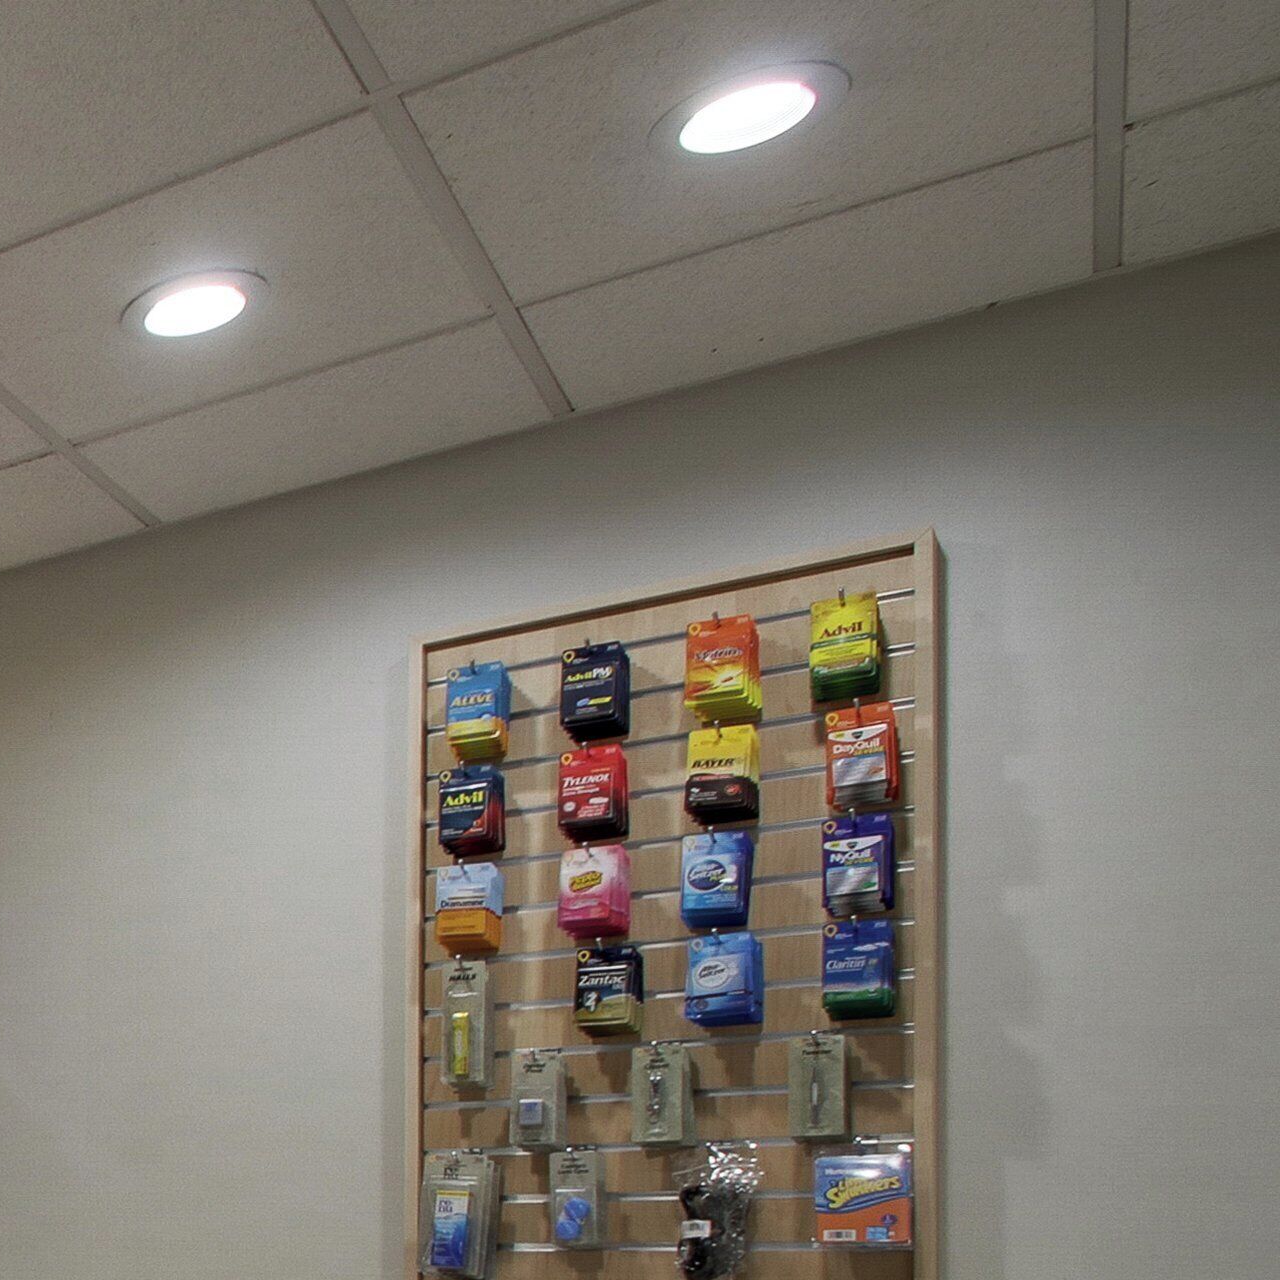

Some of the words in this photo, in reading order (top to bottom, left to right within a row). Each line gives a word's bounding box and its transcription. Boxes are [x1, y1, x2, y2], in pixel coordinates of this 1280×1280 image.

[819, 621, 864, 640] Advil
[564, 671, 592, 683] Advil
[592, 666, 613, 680] PM
[450, 693, 494, 708] ALEVE
[832, 739, 880, 755] DayQuil
[691, 758, 736, 770] BAYER
[562, 773, 611, 789] TYLENOL
[443, 790, 484, 807] Advil
[829, 848, 872, 865] NyQuil
[440, 900, 486, 909] Dramamine
[826, 957, 867, 971] Claritin
[578, 974, 626, 986] Zantac
